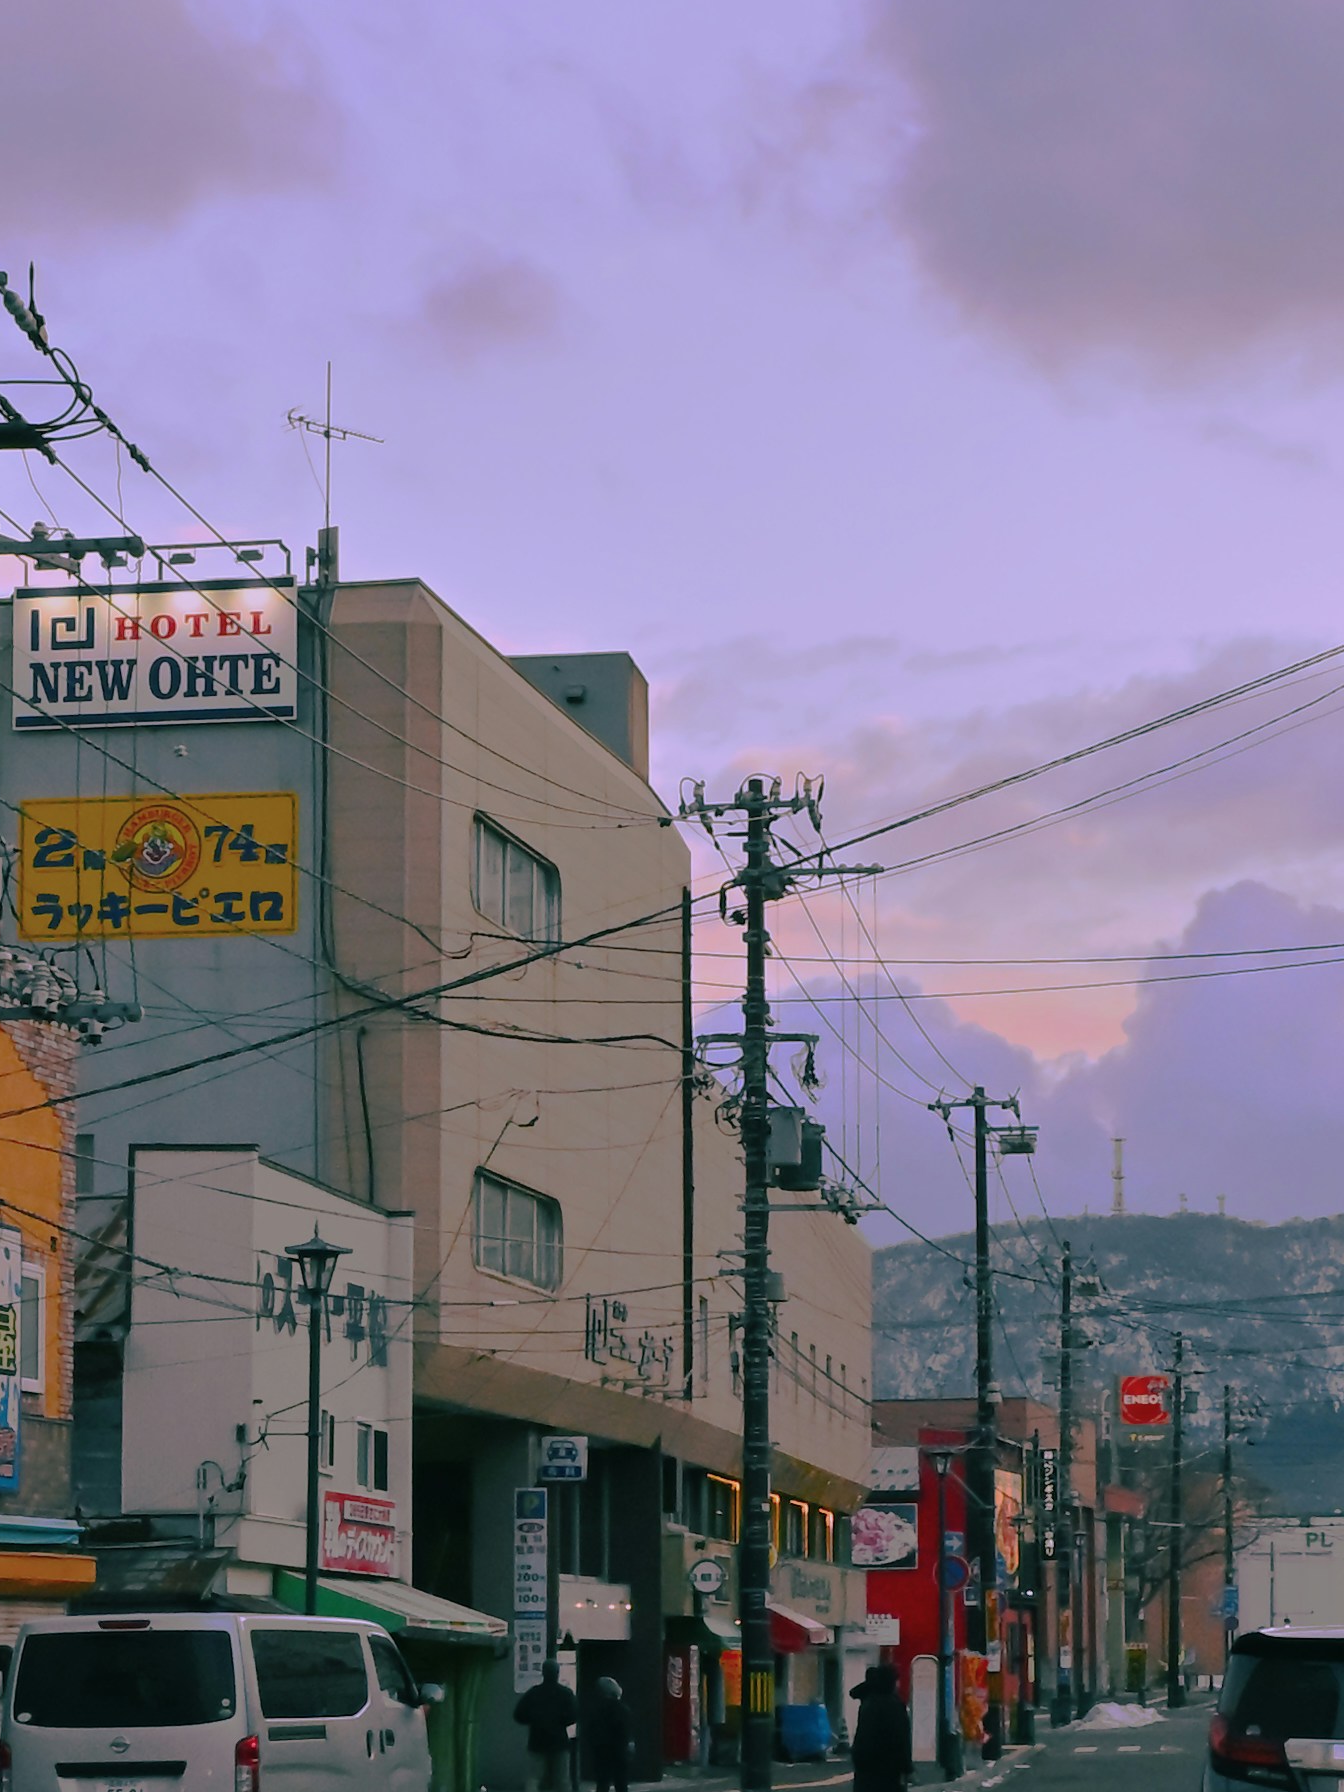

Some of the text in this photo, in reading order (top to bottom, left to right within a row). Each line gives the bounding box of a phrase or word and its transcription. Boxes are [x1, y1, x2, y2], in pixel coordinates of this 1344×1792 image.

[114, 610, 273, 642] HOTEL
[29, 652, 282, 704] NEW OHTE
[30, 888, 285, 930] ラッキーピエロ
